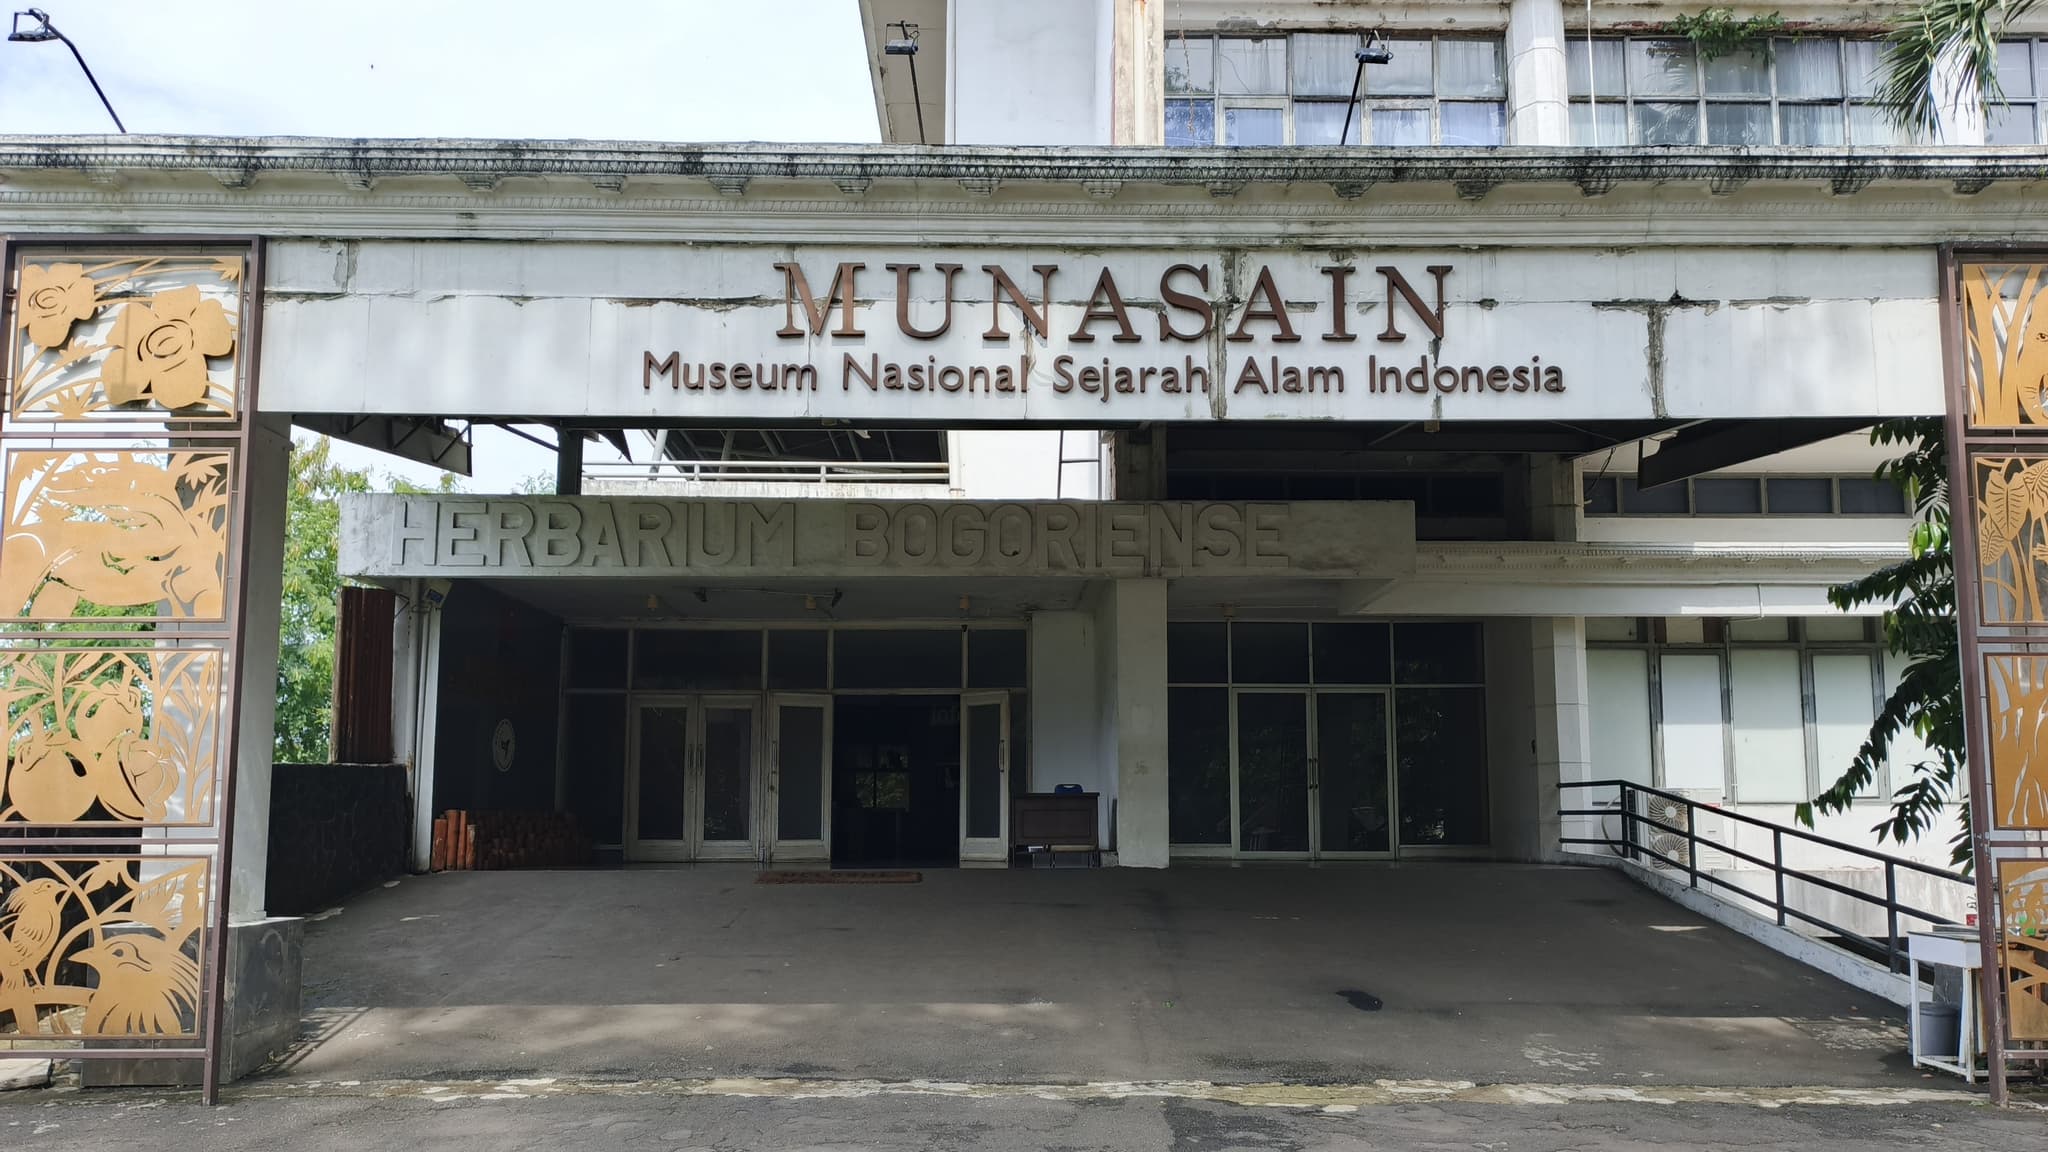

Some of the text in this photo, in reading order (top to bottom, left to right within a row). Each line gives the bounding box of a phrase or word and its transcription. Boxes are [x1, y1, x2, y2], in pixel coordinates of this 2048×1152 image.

[773, 262, 1453, 342] MUNASAIN
[643, 351, 1566, 402] Museum Nasional Sejarah Alam Indonesia
[391, 501, 1290, 568] HERBARIUM BOGORIENSE
